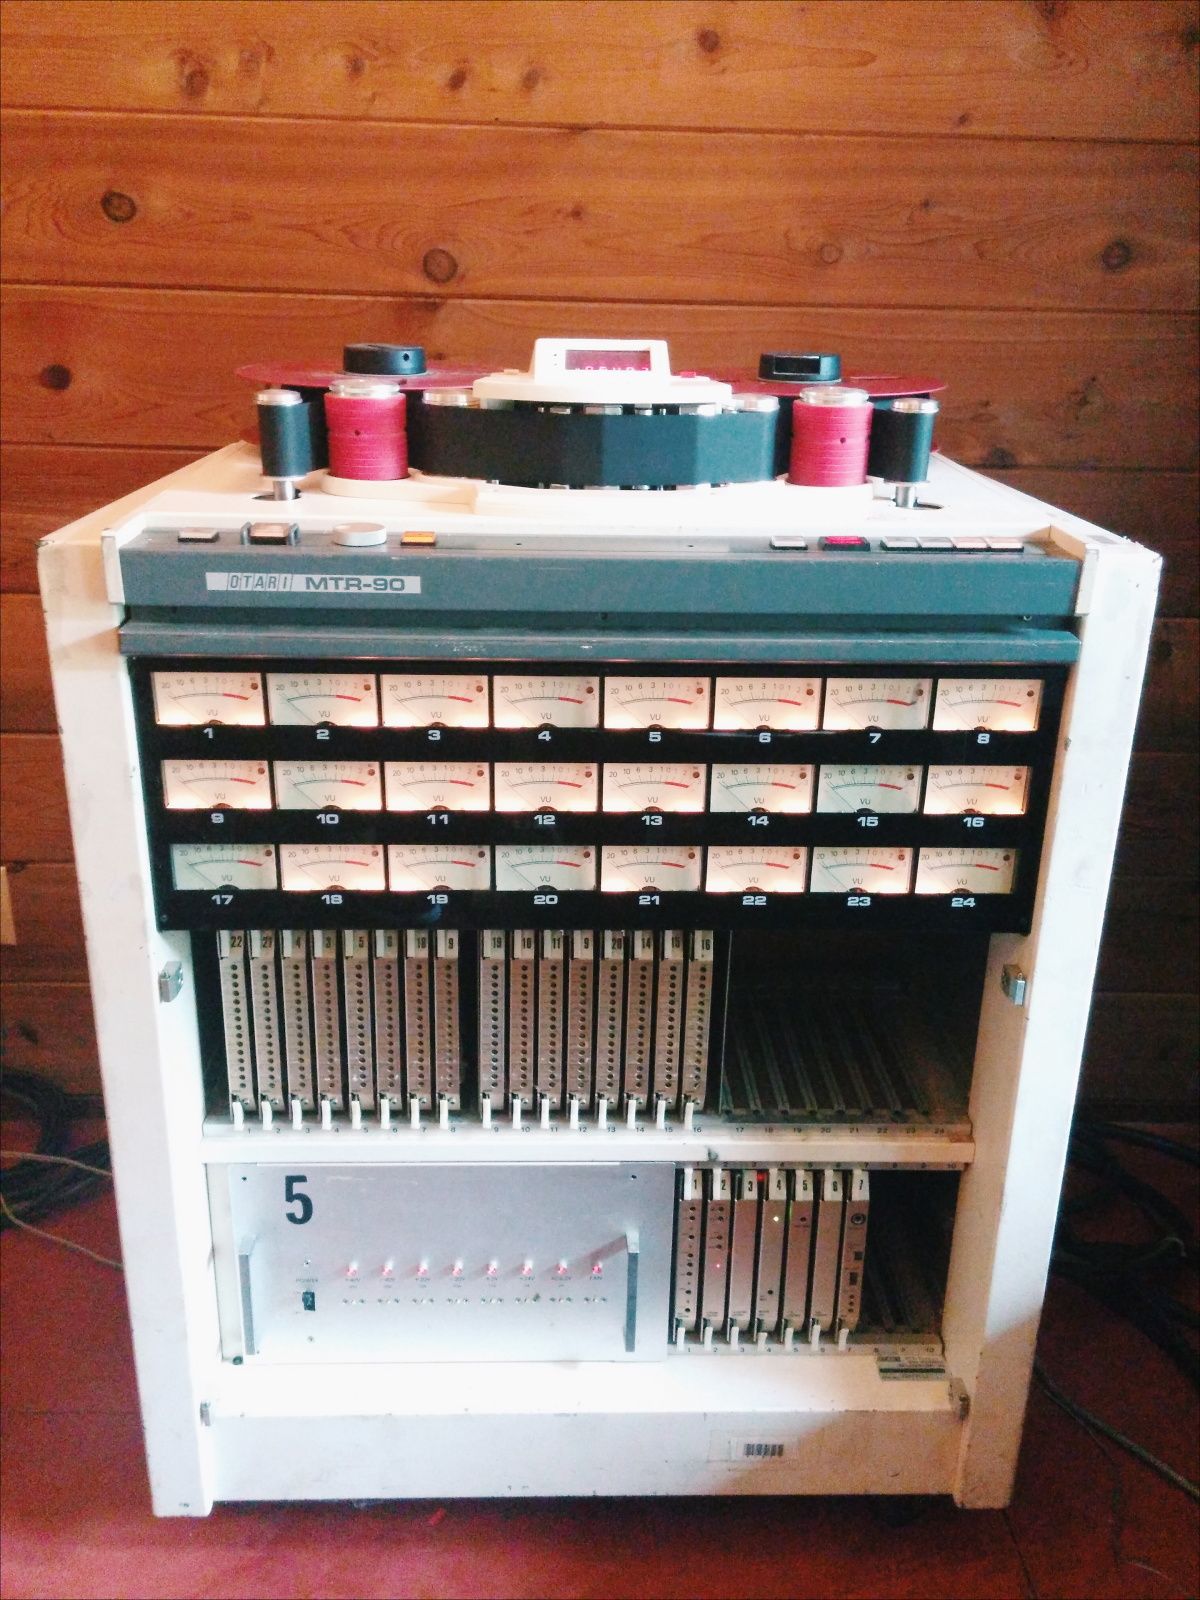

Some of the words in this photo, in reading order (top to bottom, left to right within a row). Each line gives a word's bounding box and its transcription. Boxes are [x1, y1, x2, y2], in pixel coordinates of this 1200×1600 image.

[230, 575, 287, 589] OTARI
[305, 577, 405, 591] MTR-90
[203, 728, 214, 738] 1
[316, 729, 330, 740] 2
[428, 730, 440, 740] 3
[538, 731, 551, 741] 4
[649, 732, 661, 742] 5
[759, 733, 771, 742] 6
[869, 733, 882, 743] 7
[977, 734, 990, 744] 8
[211, 814, 225, 823] 9
[316, 814, 339, 823] 10
[427, 814, 448, 824] 11
[534, 815, 555, 824] 12
[641, 816, 662, 825] 13
[748, 816, 769, 826] 14
[857, 816, 878, 826] 15
[963, 817, 984, 827] 16
[211, 895, 233, 904] 17
[321, 894, 343, 904] 18
[427, 894, 448, 904] 19
[534, 895, 558, 904] 20
[639, 896, 659, 905] 21
[743, 896, 767, 905] 22
[847, 897, 870, 906] 23
[952, 898, 976, 907] 24
[231, 936, 242, 948] 22
[359, 937, 364, 948] 5
[493, 938, 502, 948] 19
[552, 938, 561, 949] 11
[641, 938, 650, 948] 14
[702, 939, 710, 950] 16
[694, 1180, 697, 1189] 1
[722, 1180, 726, 1190] 2
[748, 1181, 752, 1191] 3
[777, 1180, 781, 1190] 4
[803, 1181, 807, 1190] 5
[833, 1181, 837, 1191] 6
[859, 1180, 863, 1190] 7
[285, 1175, 313, 1224] 5
